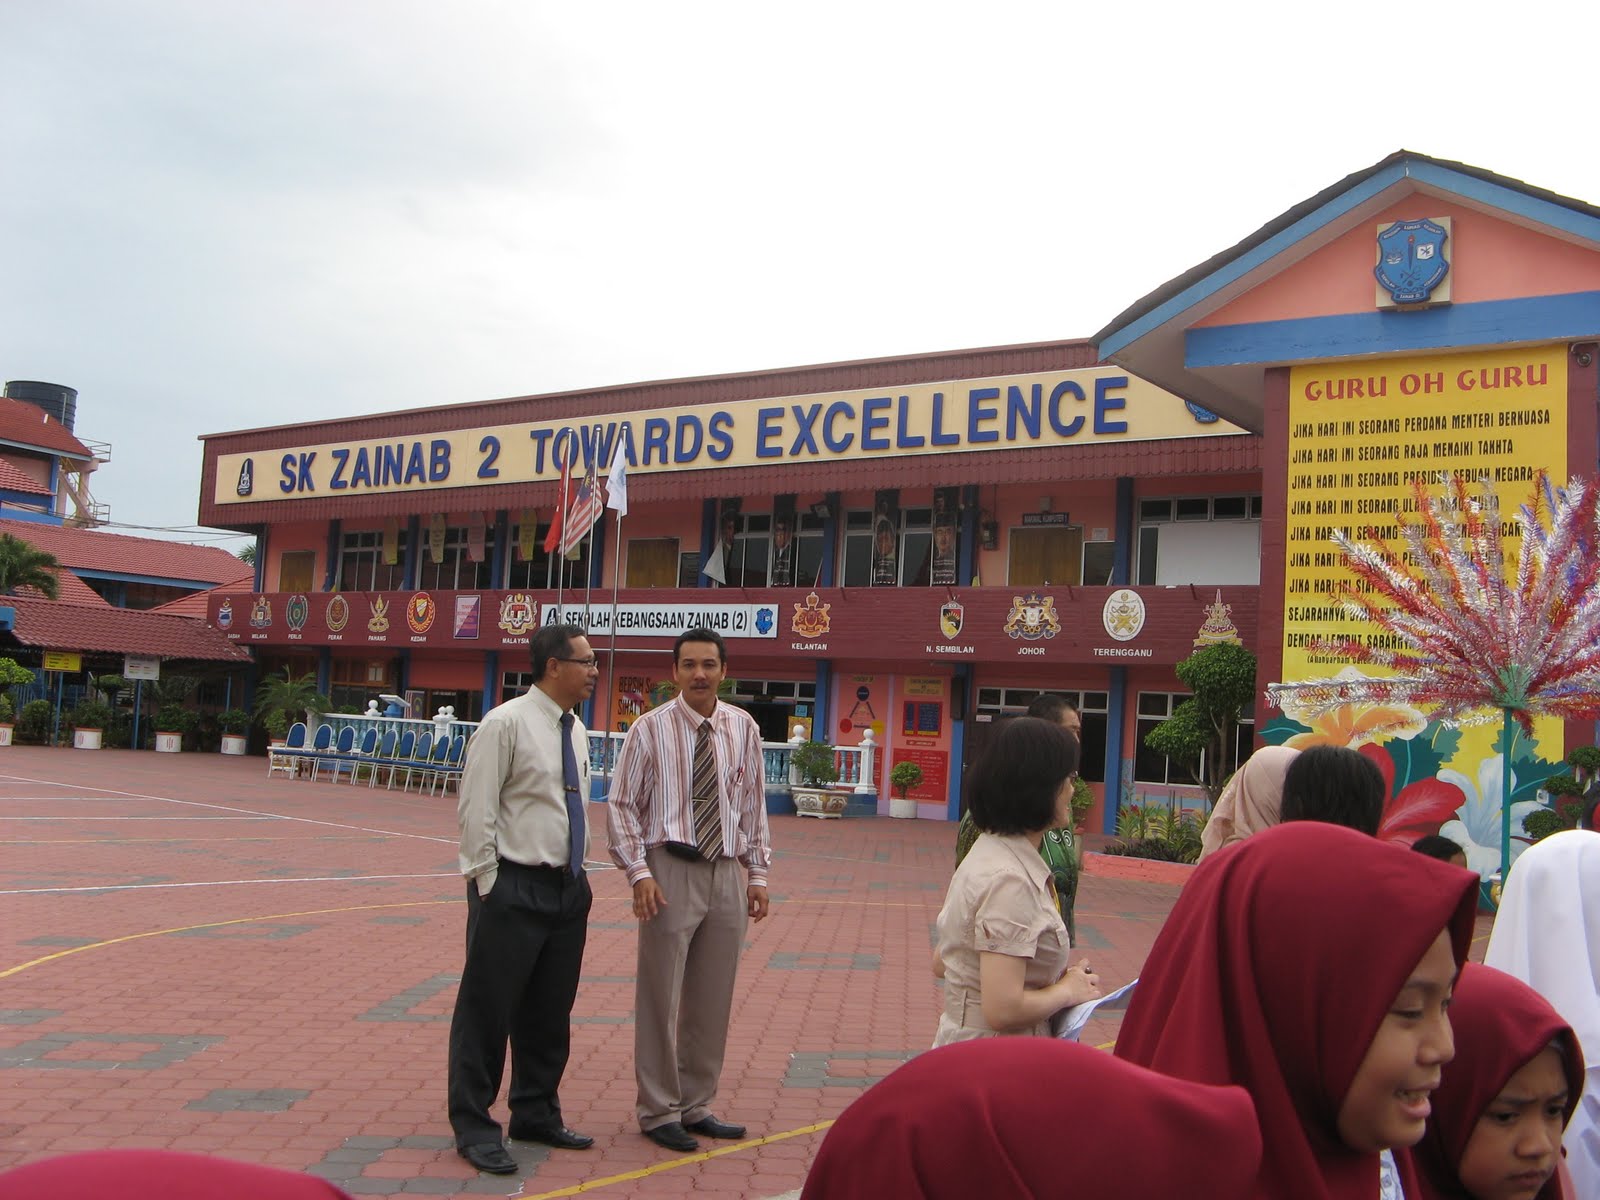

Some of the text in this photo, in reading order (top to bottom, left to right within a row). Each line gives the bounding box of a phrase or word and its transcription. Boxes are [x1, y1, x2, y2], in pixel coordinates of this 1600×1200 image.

[1304, 363, 1548, 401] GURU OH GURU
[1293, 409, 1550, 438] JIKA HARI INI SEORANG PERDANA MENTERI BERKUASA
[279, 376, 1128, 494] SK ZAINAB 2 TOWARDS EXCELLENCE
[1293, 439, 1513, 464] JIKA HARI INI SEORANG RAJA MENAIKI TAKHTA
[1292, 475, 1312, 489] JIKA
[1316, 474, 1337, 488] HARI
[1341, 473, 1353, 488] INI
[1357, 471, 1399, 487] SEORANG
[1495, 466, 1533, 482] NEGARA
[1291, 501, 1312, 515] JIKA
[1315, 500, 1337, 515] HARI
[1341, 499, 1353, 514] INI
[1357, 498, 1399, 514] SEORANG
[1290, 526, 1311, 541] JIKA
[1315, 525, 1337, 541] HAR
[1290, 552, 1310, 567] JIKA
[1314, 552, 1336, 567] HARI
[1289, 578, 1310, 593] JIKA
[1314, 578, 1335, 593] HARI
[1339, 578, 1352, 593] INI
[565, 610, 748, 632] SEKOLAH KEBANGSAAN ZAINAB (2)
[1288, 606, 1346, 621] SEJARAHNYA
[502, 637, 530, 645] MALAYSIA
[791, 643, 828, 651] KELANTAN
[926, 645, 975, 654] N. SEMBILAN
[1017, 647, 1046, 656] JOHOR
[1093, 648, 1153, 658] TERENGGANU
